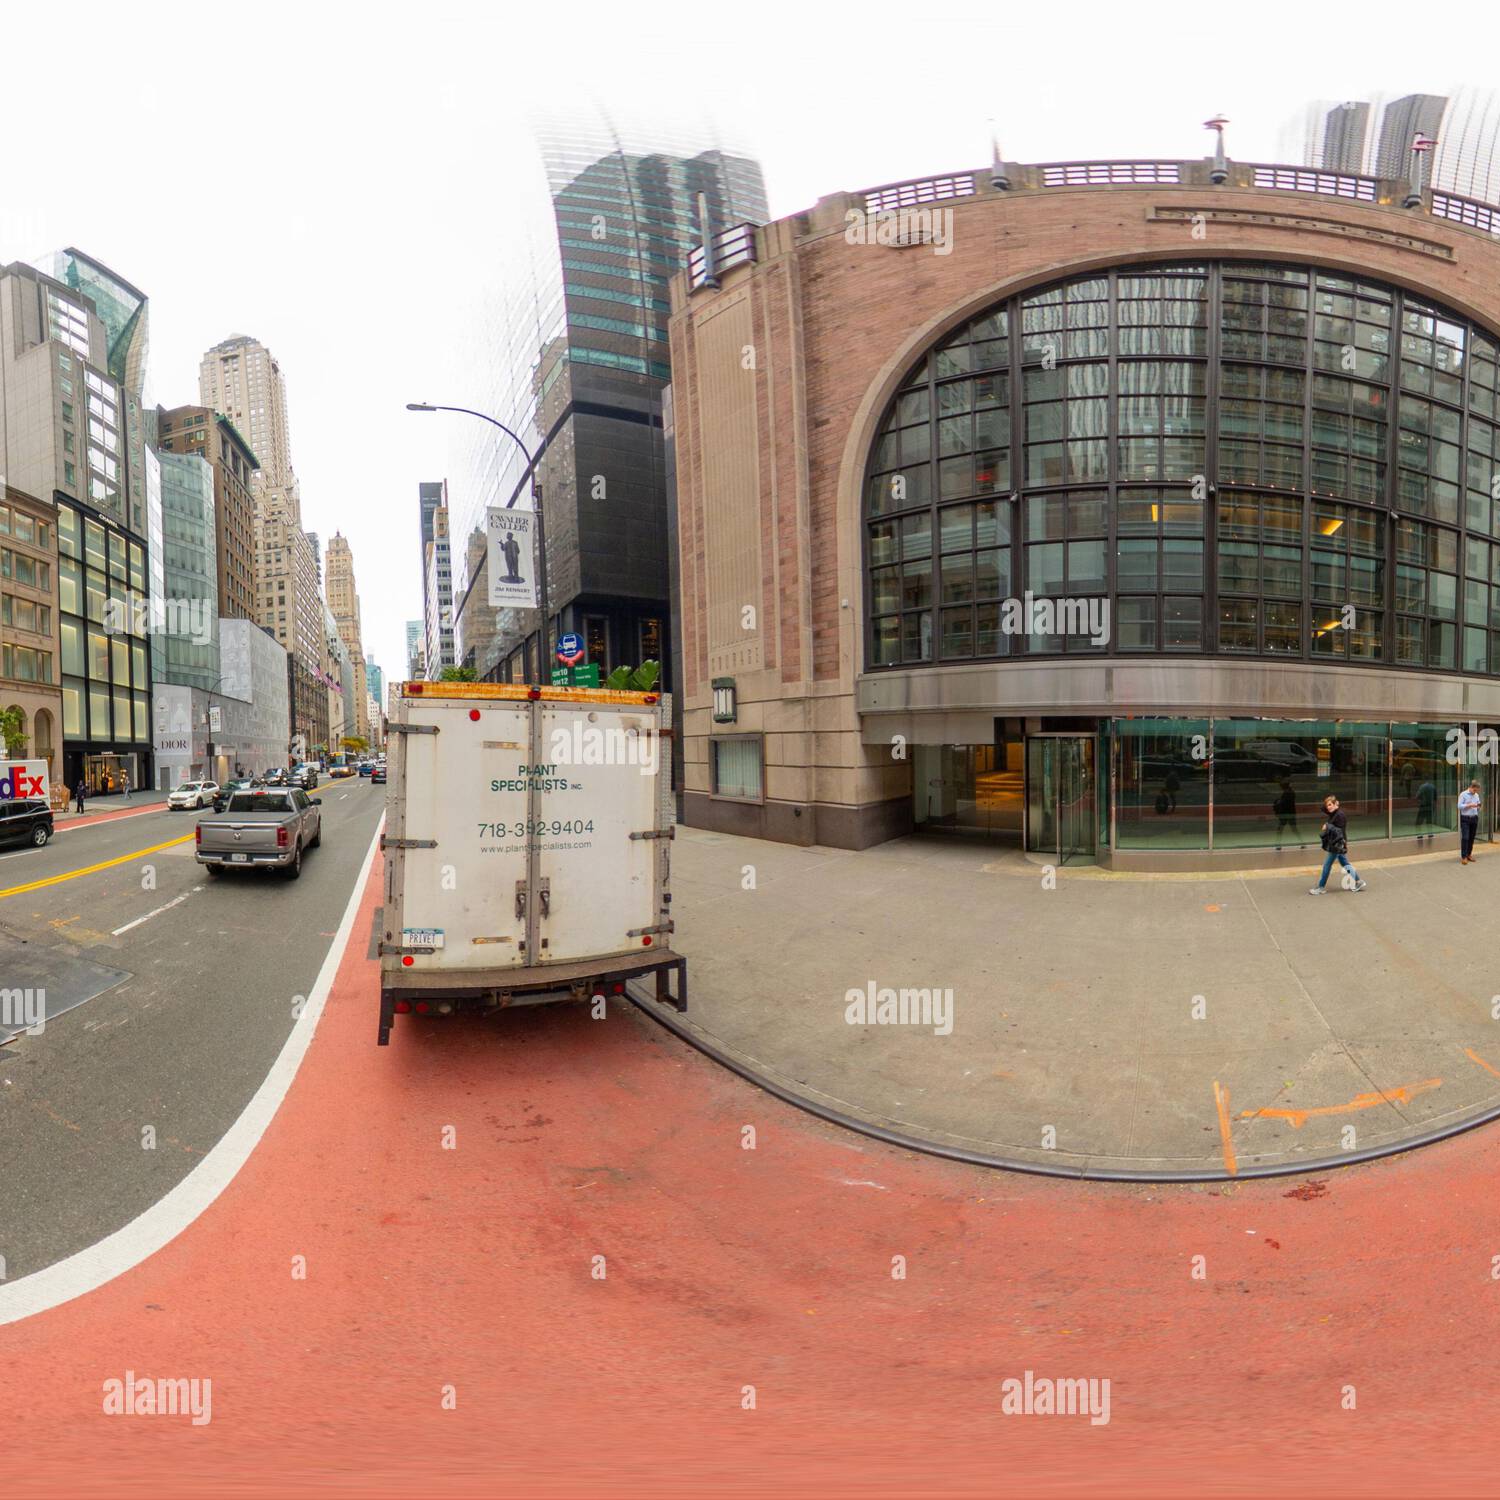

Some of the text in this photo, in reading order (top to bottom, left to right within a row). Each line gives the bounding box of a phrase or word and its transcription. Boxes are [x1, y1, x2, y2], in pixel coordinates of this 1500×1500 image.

[490, 520, 528, 533] GALLERY
[161, 740, 187, 749] DIOR
[518, 764, 557, 776] PLANT
[491, 778, 568, 791] SPECIALISTS
